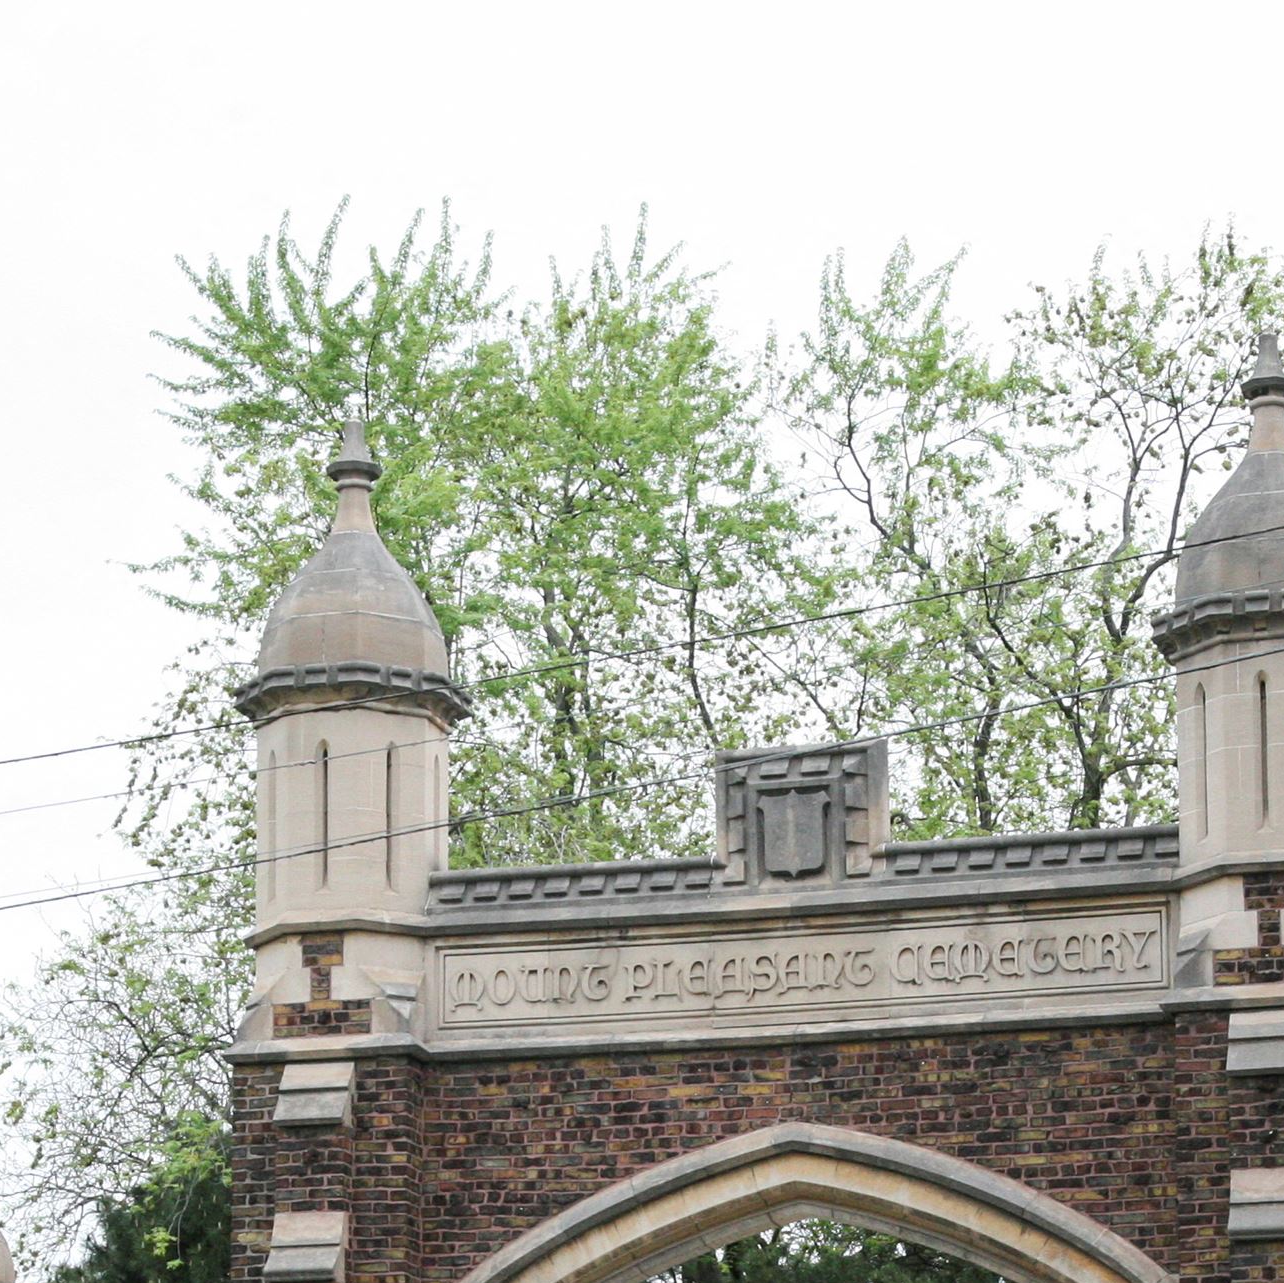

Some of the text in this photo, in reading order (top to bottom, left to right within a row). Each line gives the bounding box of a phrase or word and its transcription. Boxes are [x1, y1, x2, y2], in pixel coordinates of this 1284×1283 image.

[449, 929, 1156, 1012] MOUNT PLEASANT CEMETERY
